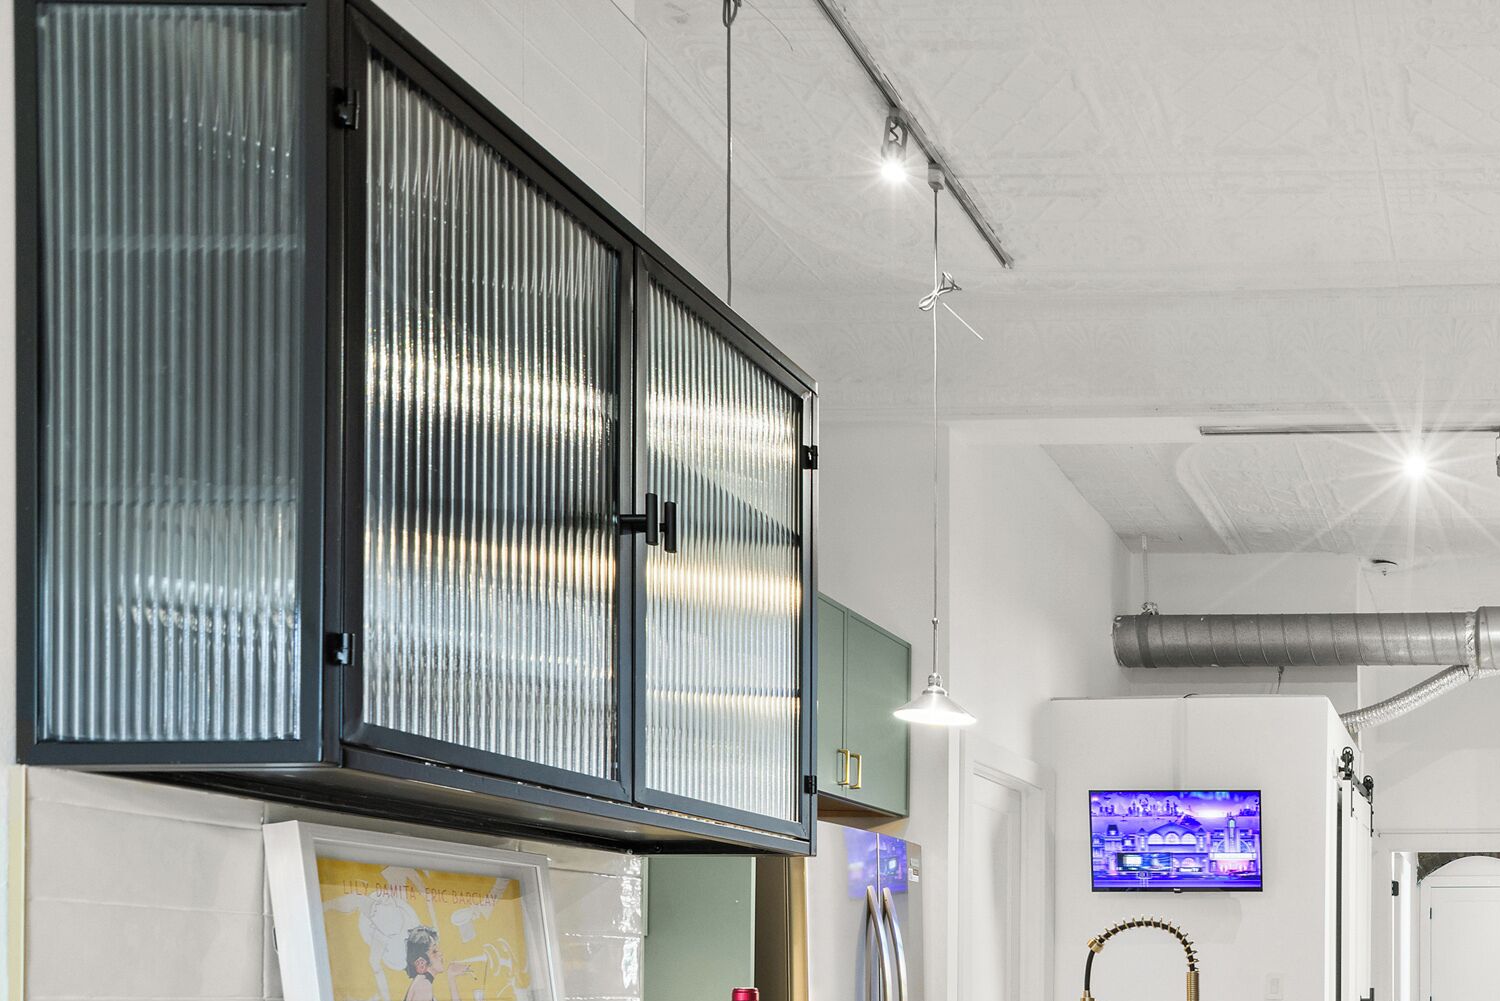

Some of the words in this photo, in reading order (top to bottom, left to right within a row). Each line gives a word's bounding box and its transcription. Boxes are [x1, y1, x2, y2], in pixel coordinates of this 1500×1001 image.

[342, 879, 369, 896] LILY
[375, 882, 417, 901] DAMITA
[424, 886, 450, 904] ERIC
[451, 890, 498, 907] BARCLAY
